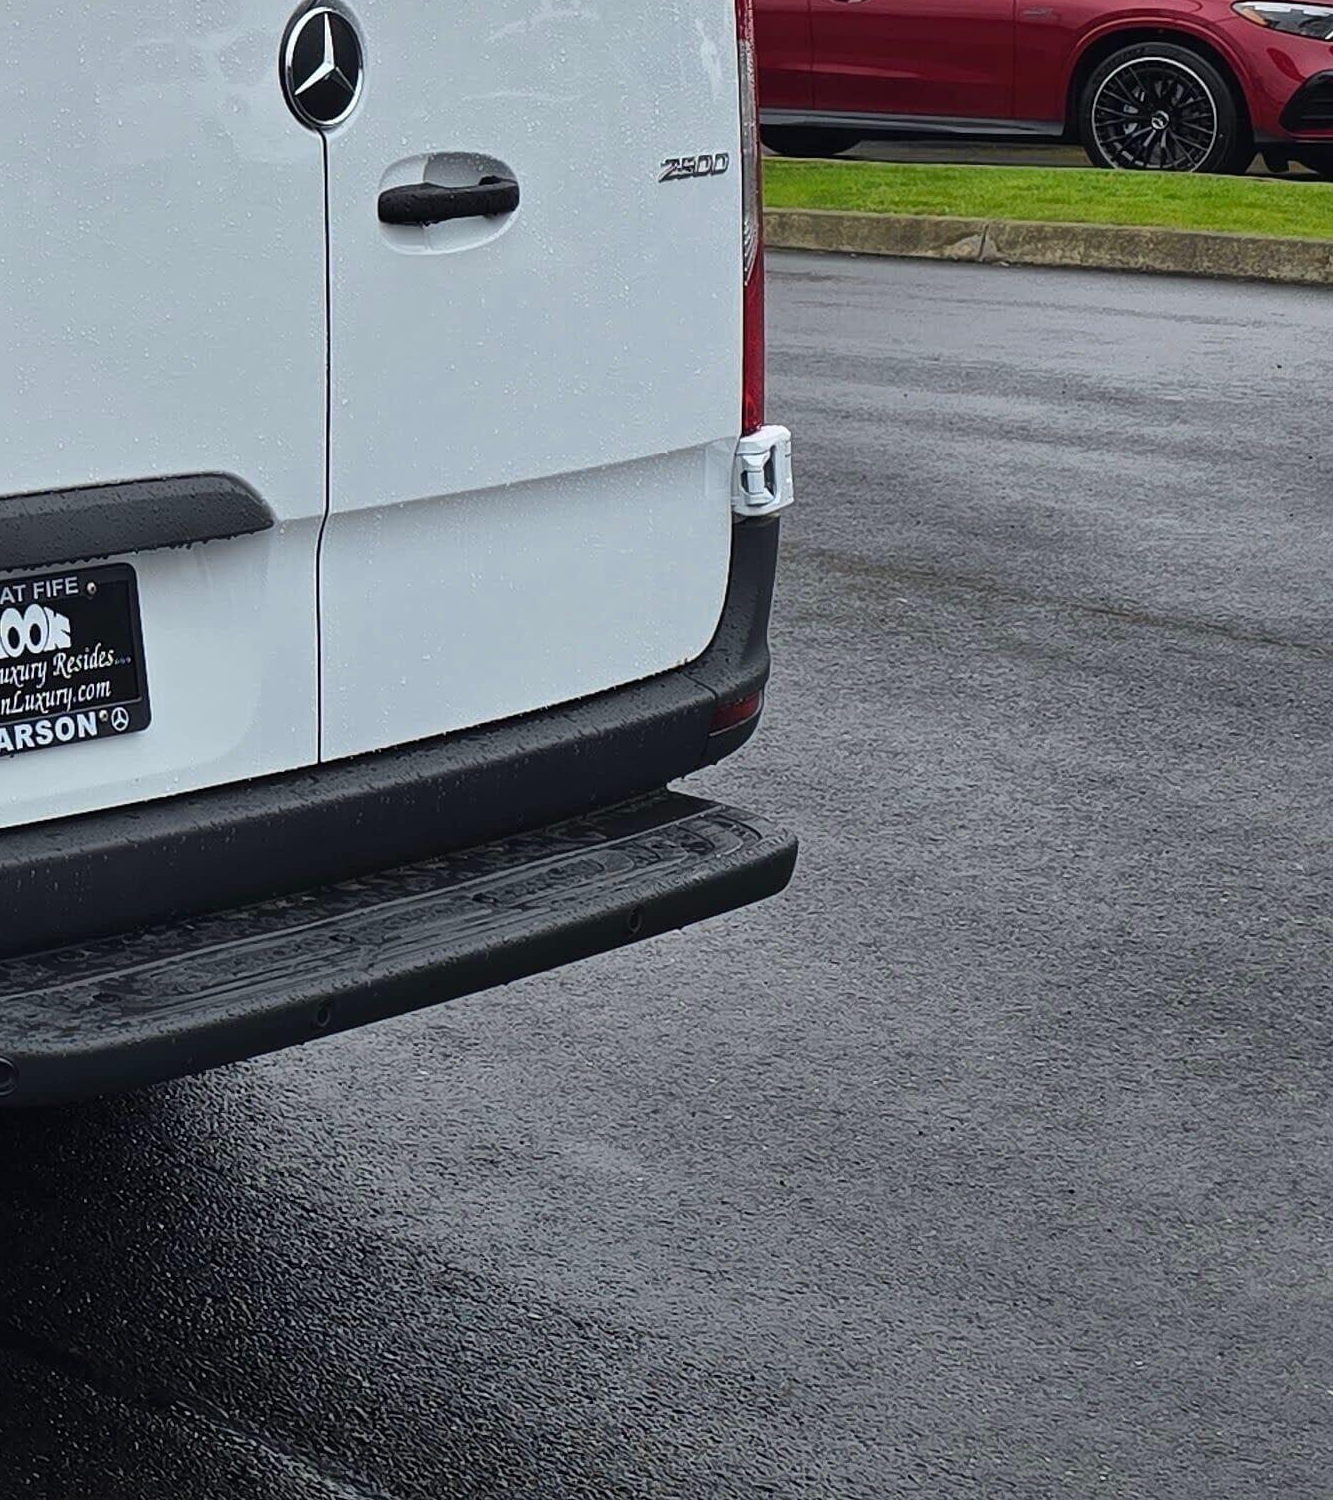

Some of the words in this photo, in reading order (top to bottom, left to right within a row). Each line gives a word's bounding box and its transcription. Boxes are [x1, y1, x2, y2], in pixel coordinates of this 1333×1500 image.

[658, 153, 729, 183] 2500
[0, 585, 26, 605] AT
[33, 577, 79, 600] FIFE
